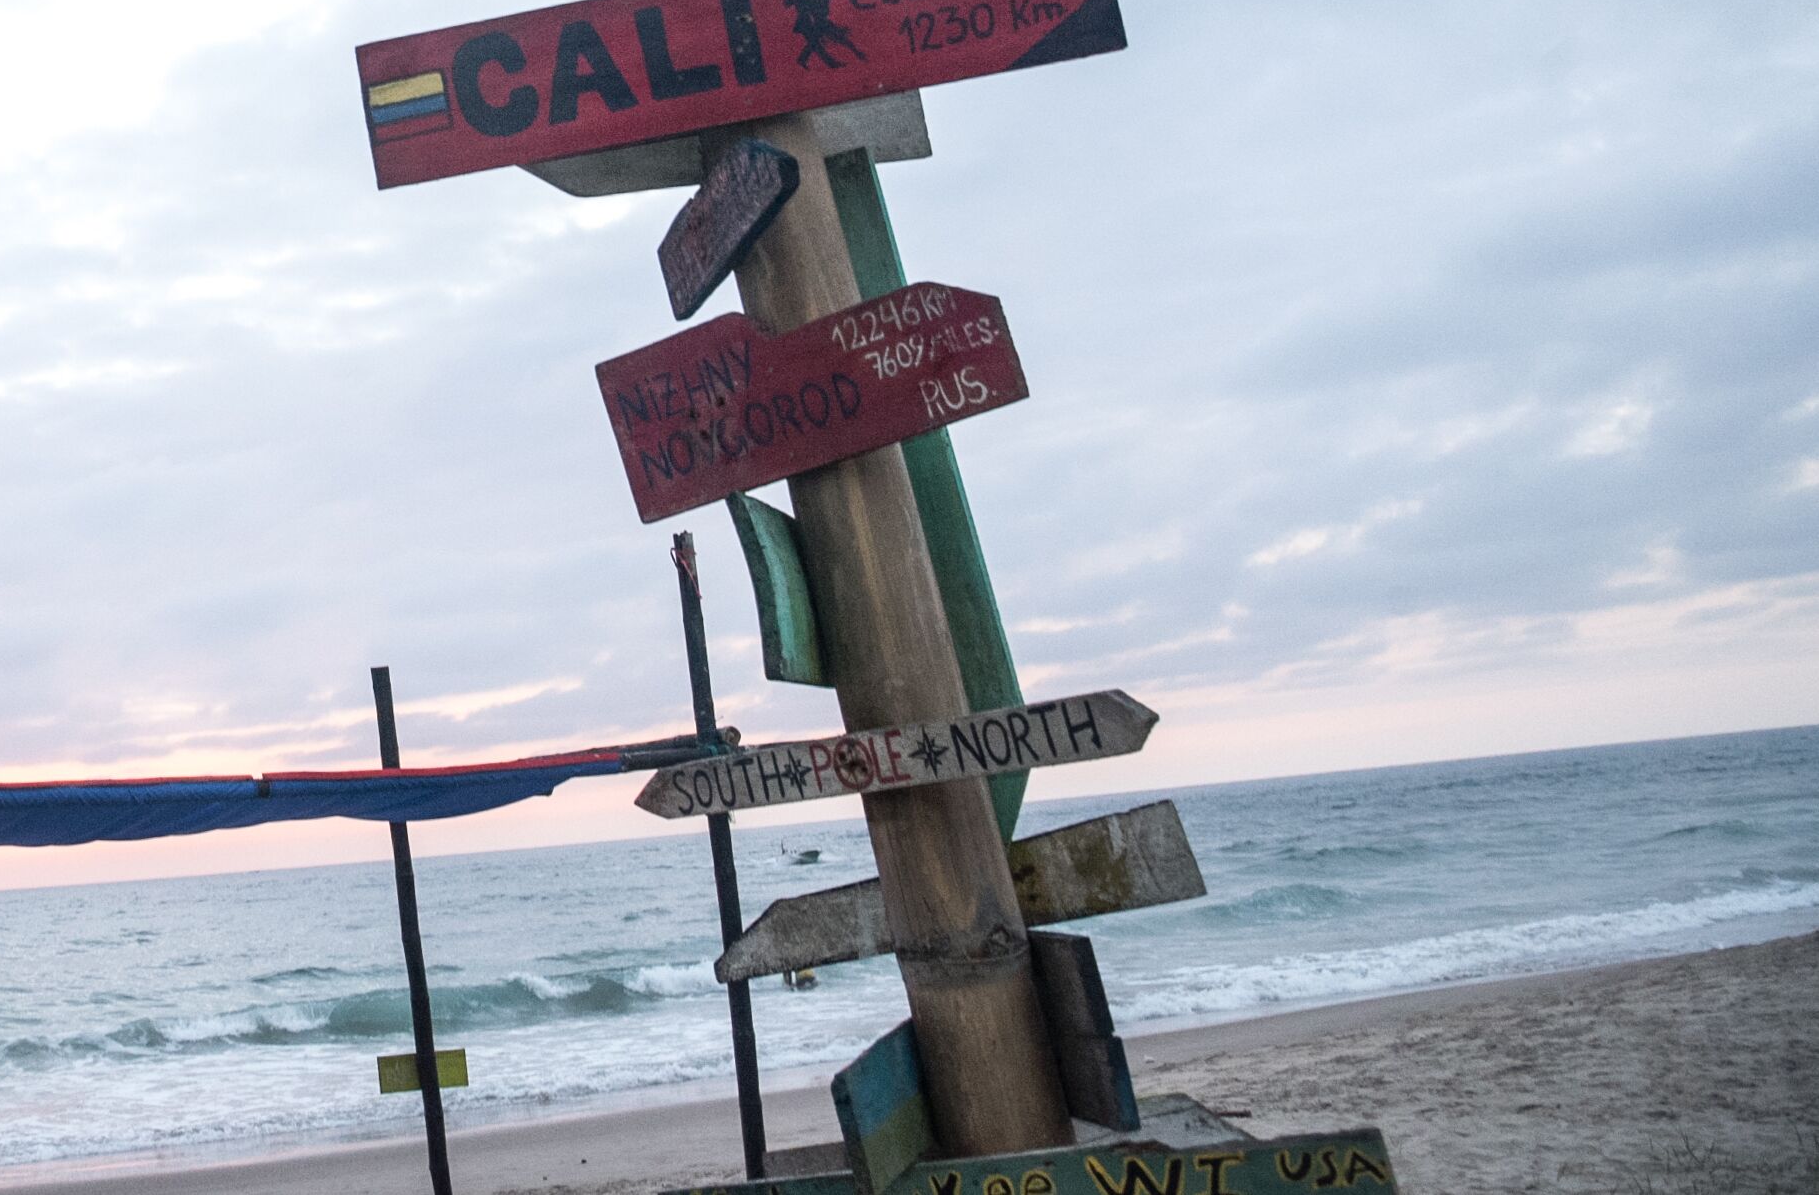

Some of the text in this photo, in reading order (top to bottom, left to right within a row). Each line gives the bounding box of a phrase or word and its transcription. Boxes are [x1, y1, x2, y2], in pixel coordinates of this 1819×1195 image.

[898, 4, 995, 57] 1230
[671, 699, 1102, 816] SOUTH POLE NORTH
[1277, 1149, 1392, 1189] USA
